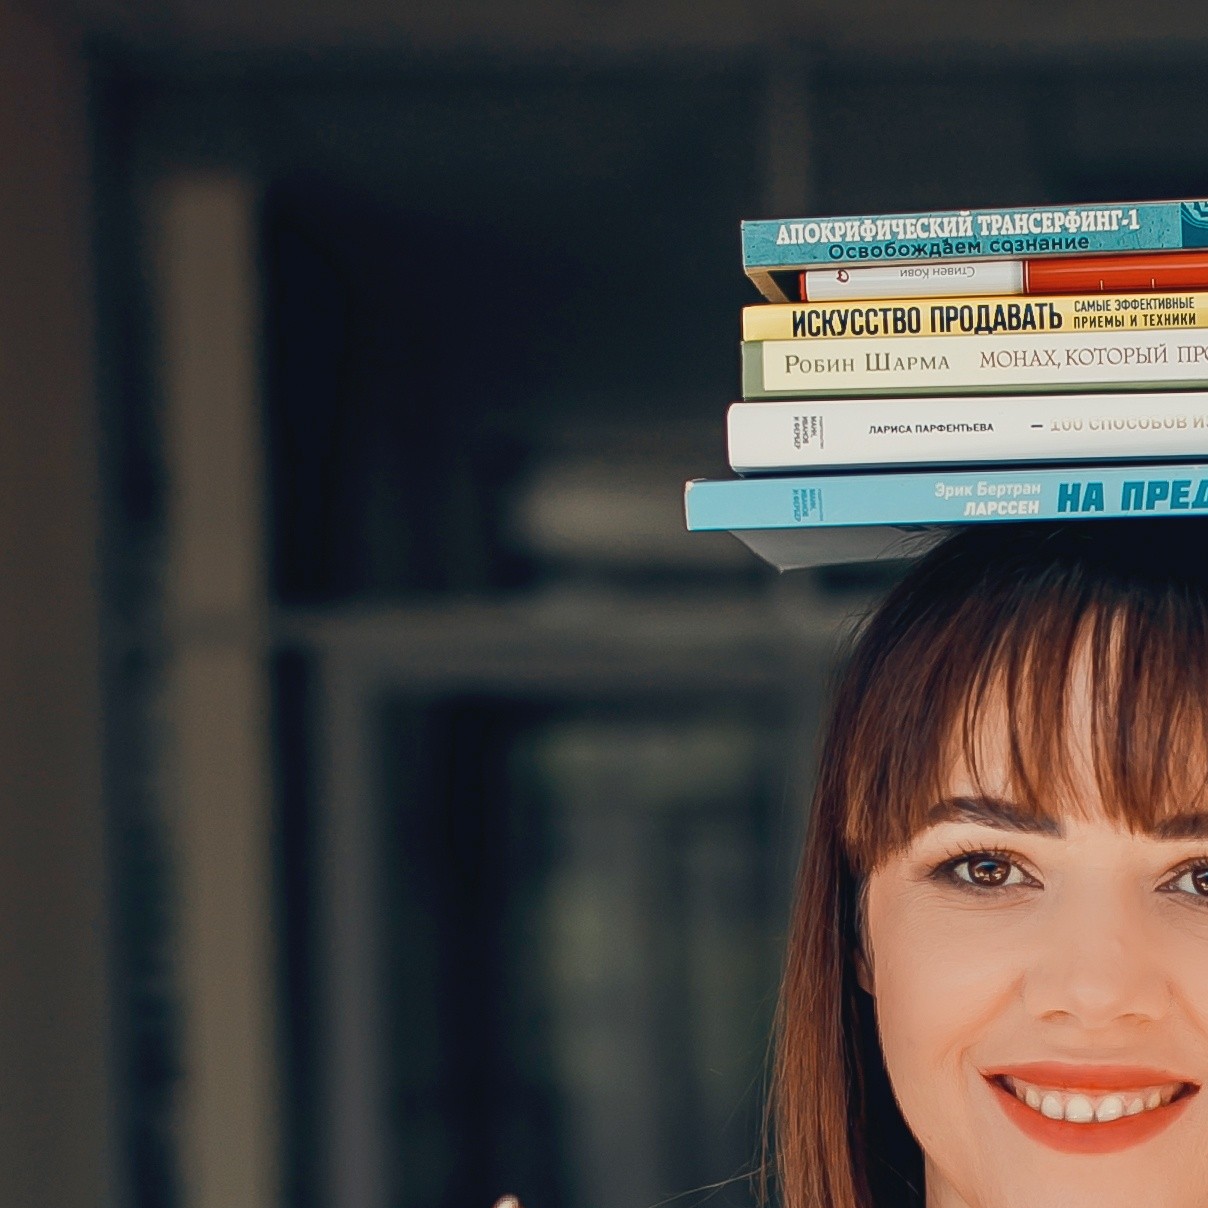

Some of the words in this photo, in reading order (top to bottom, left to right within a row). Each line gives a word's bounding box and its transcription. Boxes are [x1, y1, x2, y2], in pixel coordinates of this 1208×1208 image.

[776, 210, 973, 245] АПОКРИФИЧЕСКИЙ
[978, 208, 1140, 236] ТРАНСЕРФИНГ-1
[828, 238, 981, 260] Освобождаем
[989, 235, 1090, 252] сознание
[900, 267, 930, 279] Кови
[932, 266, 975, 278] Стивен
[1074, 299, 1112, 313] САМЫЕ
[1114, 296, 1195, 311] ЭФФЕКТИВНЫЕ
[792, 306, 921, 337] ИСКУССТВО
[930, 303, 1063, 335] ПРОДАВАТЬ
[1073, 314, 1125, 329] ПРИЕМЫ
[1129, 314, 1138, 327] И
[1142, 312, 1196, 326] ТЕХНИКИ
[979, 349, 1061, 369] МОНАХ,
[1066, 344, 1168, 367] КОТОРЫЙ
[869, 423, 912, 435] ЛАРИСА
[915, 422, 994, 434] ПАРФЕНТЬЕВА
[1089, 415, 1187, 431] СПОСОБОВ
[935, 483, 972, 500] Эрик
[977, 481, 1041, 499] Бертран
[1057, 482, 1105, 513] НА
[964, 500, 1040, 517] ЛАРССЕН
